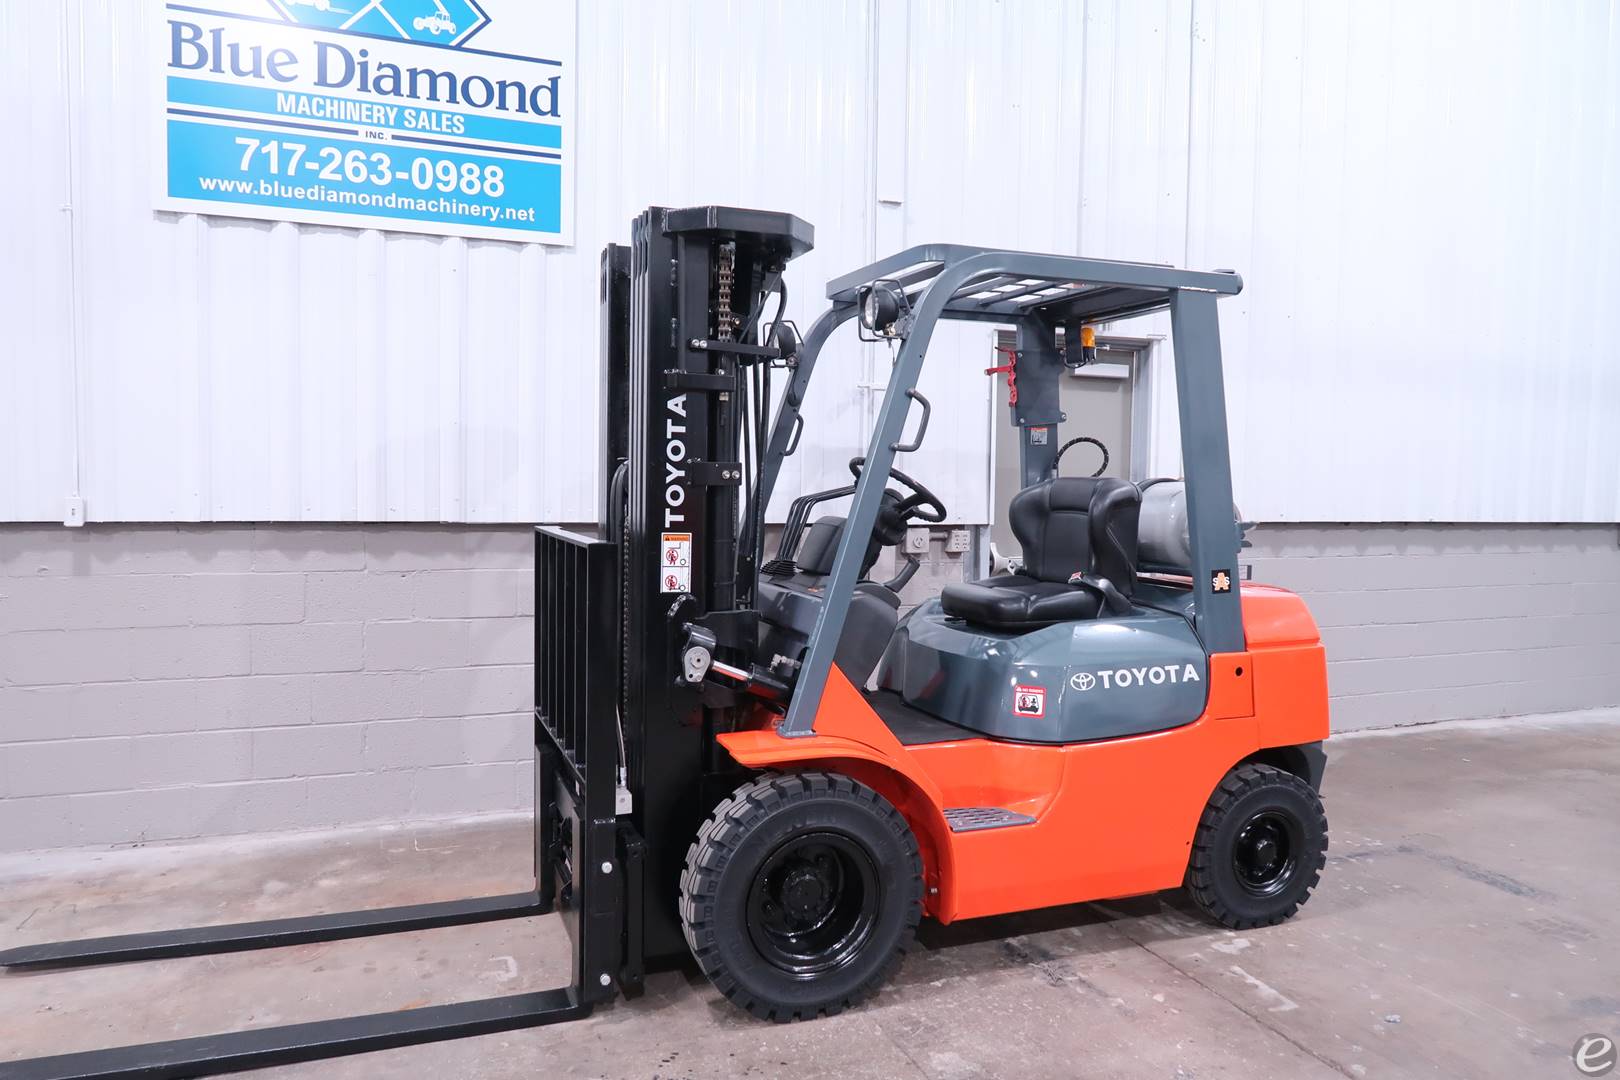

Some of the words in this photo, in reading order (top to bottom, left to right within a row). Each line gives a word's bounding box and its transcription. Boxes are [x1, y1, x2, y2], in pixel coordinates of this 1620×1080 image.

[167, 20, 298, 82] Blue
[313, 41, 561, 118] Diamond
[276, 92, 398, 126] MACHINERY
[403, 108, 465, 134] SALES
[365, 131, 388, 141] INC.
[235, 137, 505, 197] 717-263-0988
[199, 177, 535, 222] www.bluediamondmachinery.net
[665, 393, 687, 528] TOYOTA
[1098, 664, 1200, 689] TOYOTA
